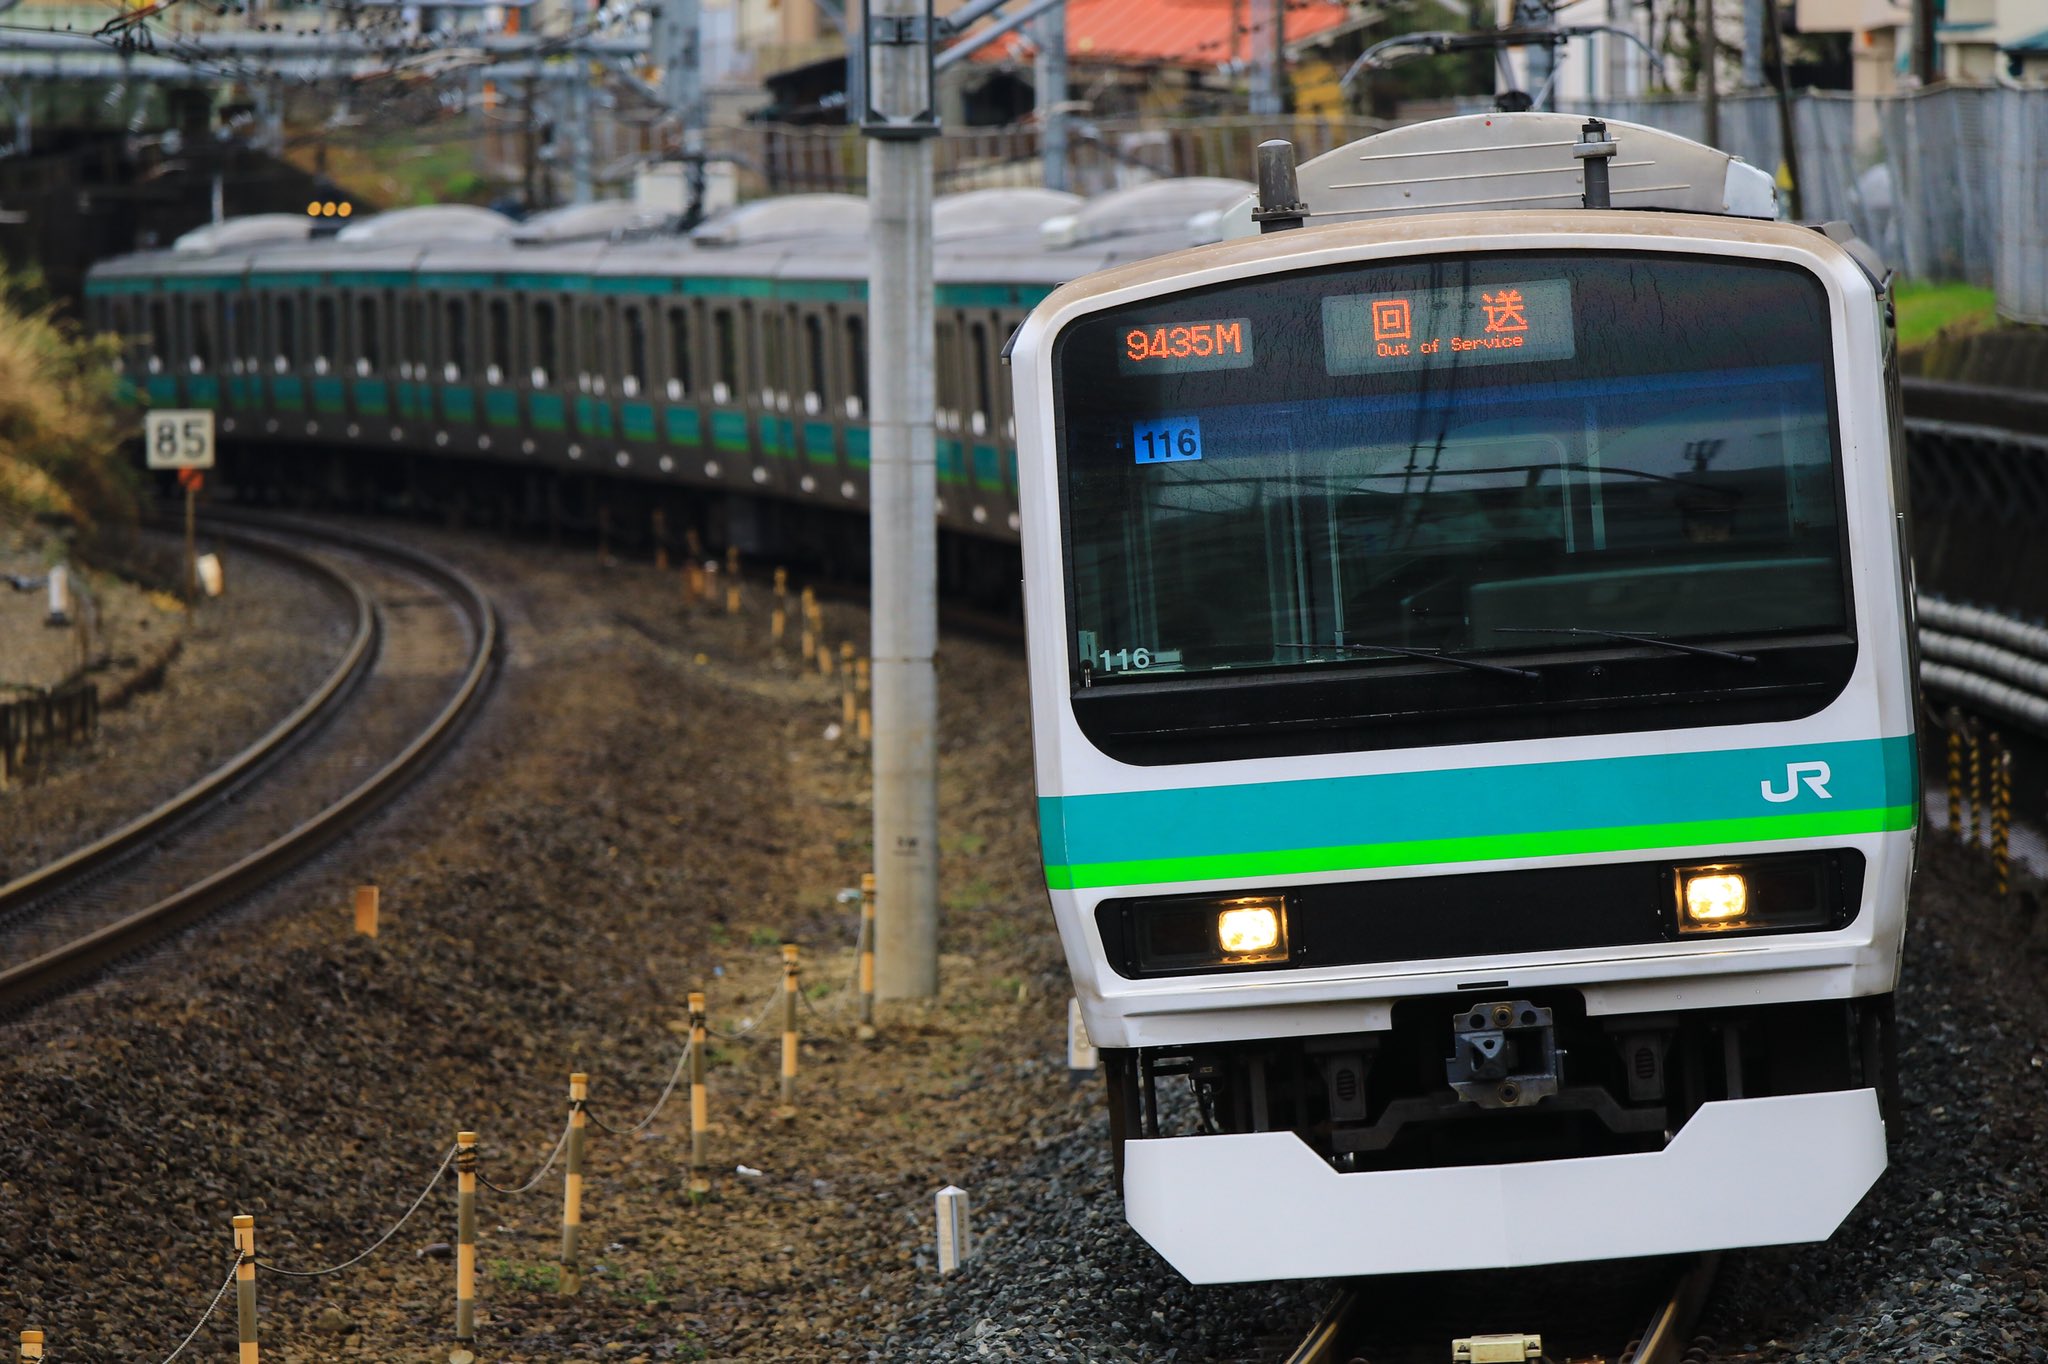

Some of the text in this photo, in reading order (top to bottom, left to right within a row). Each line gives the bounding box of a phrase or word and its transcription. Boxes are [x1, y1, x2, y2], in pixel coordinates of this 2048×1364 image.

[1126, 321, 1241, 361] 9435M
[1377, 335, 1524, 357] Out of Service
[156, 419, 206, 460] 85
[1142, 428, 1197, 459] 116
[1099, 647, 1150, 672] 116
[1760, 760, 1833, 803] JR
